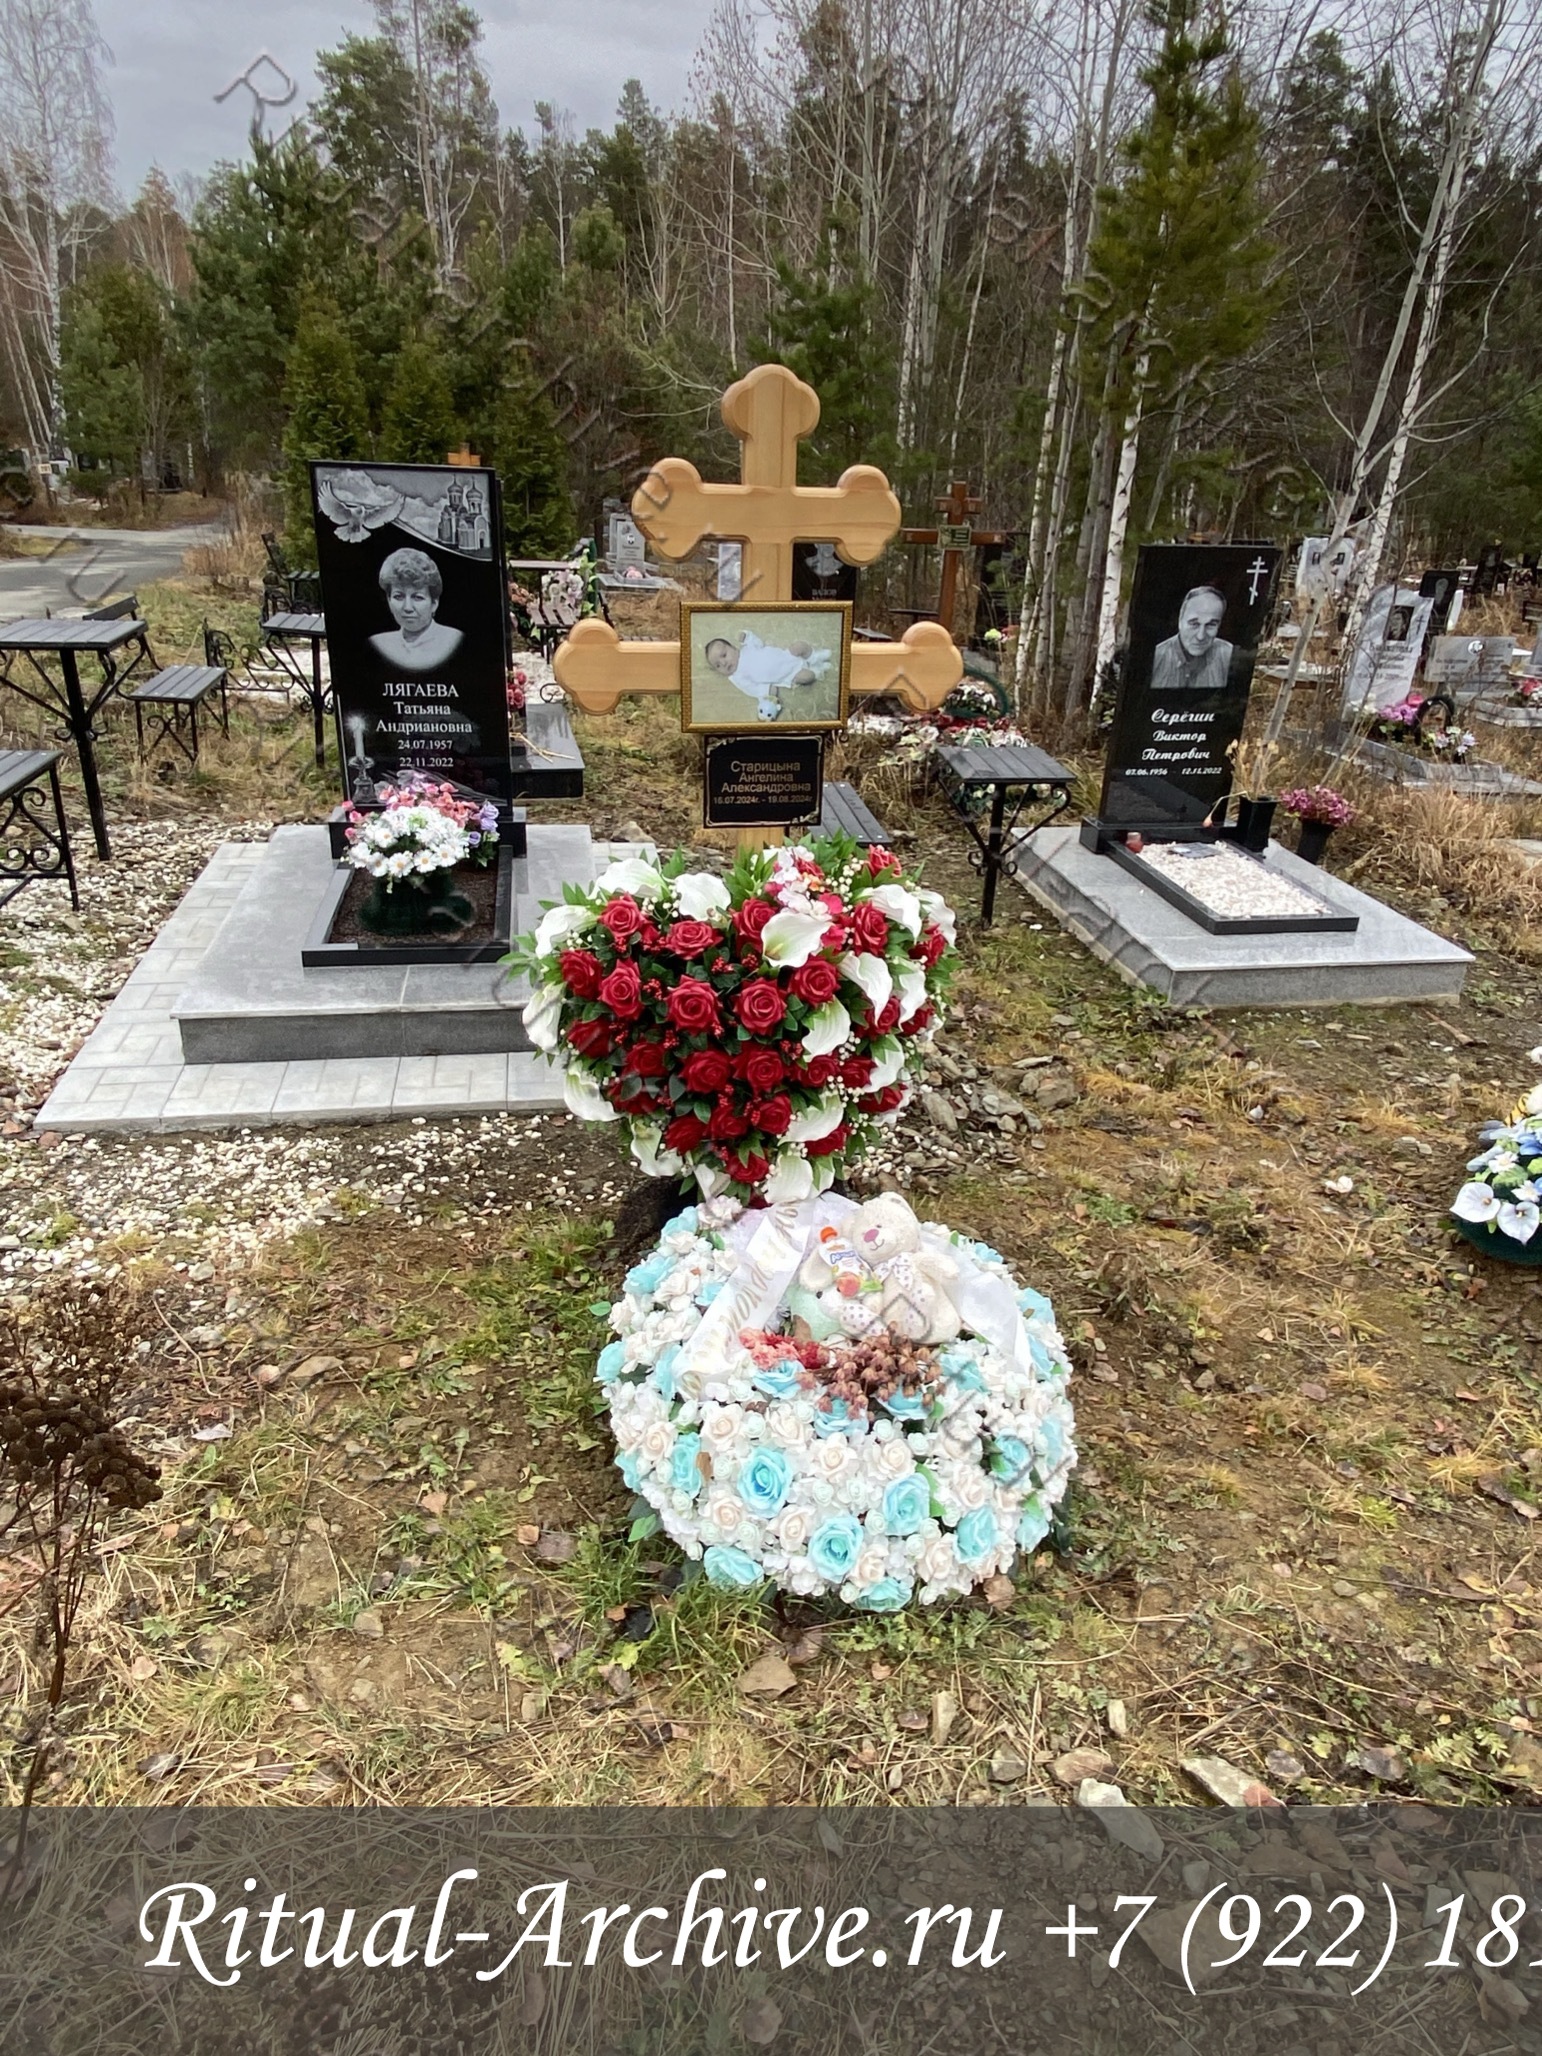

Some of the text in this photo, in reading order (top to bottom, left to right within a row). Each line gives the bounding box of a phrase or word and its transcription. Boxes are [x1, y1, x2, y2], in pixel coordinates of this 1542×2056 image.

[382, 682, 459, 698] ЛЯГАЕВА
[393, 701, 451, 715] Татьяна
[1151, 708, 1216, 726] Серёгин
[376, 719, 473, 735] Андриановна
[1152, 729, 1207, 743] Виктор
[398, 739, 453, 750] 24.07.1957
[1141, 747, 1211, 762] Петрович
[399, 757, 454, 767] 22.11.2022
[730, 760, 801, 773] Старицына
[738, 772, 794, 783] Ангелина
[721, 782, 811, 794] Александровна
